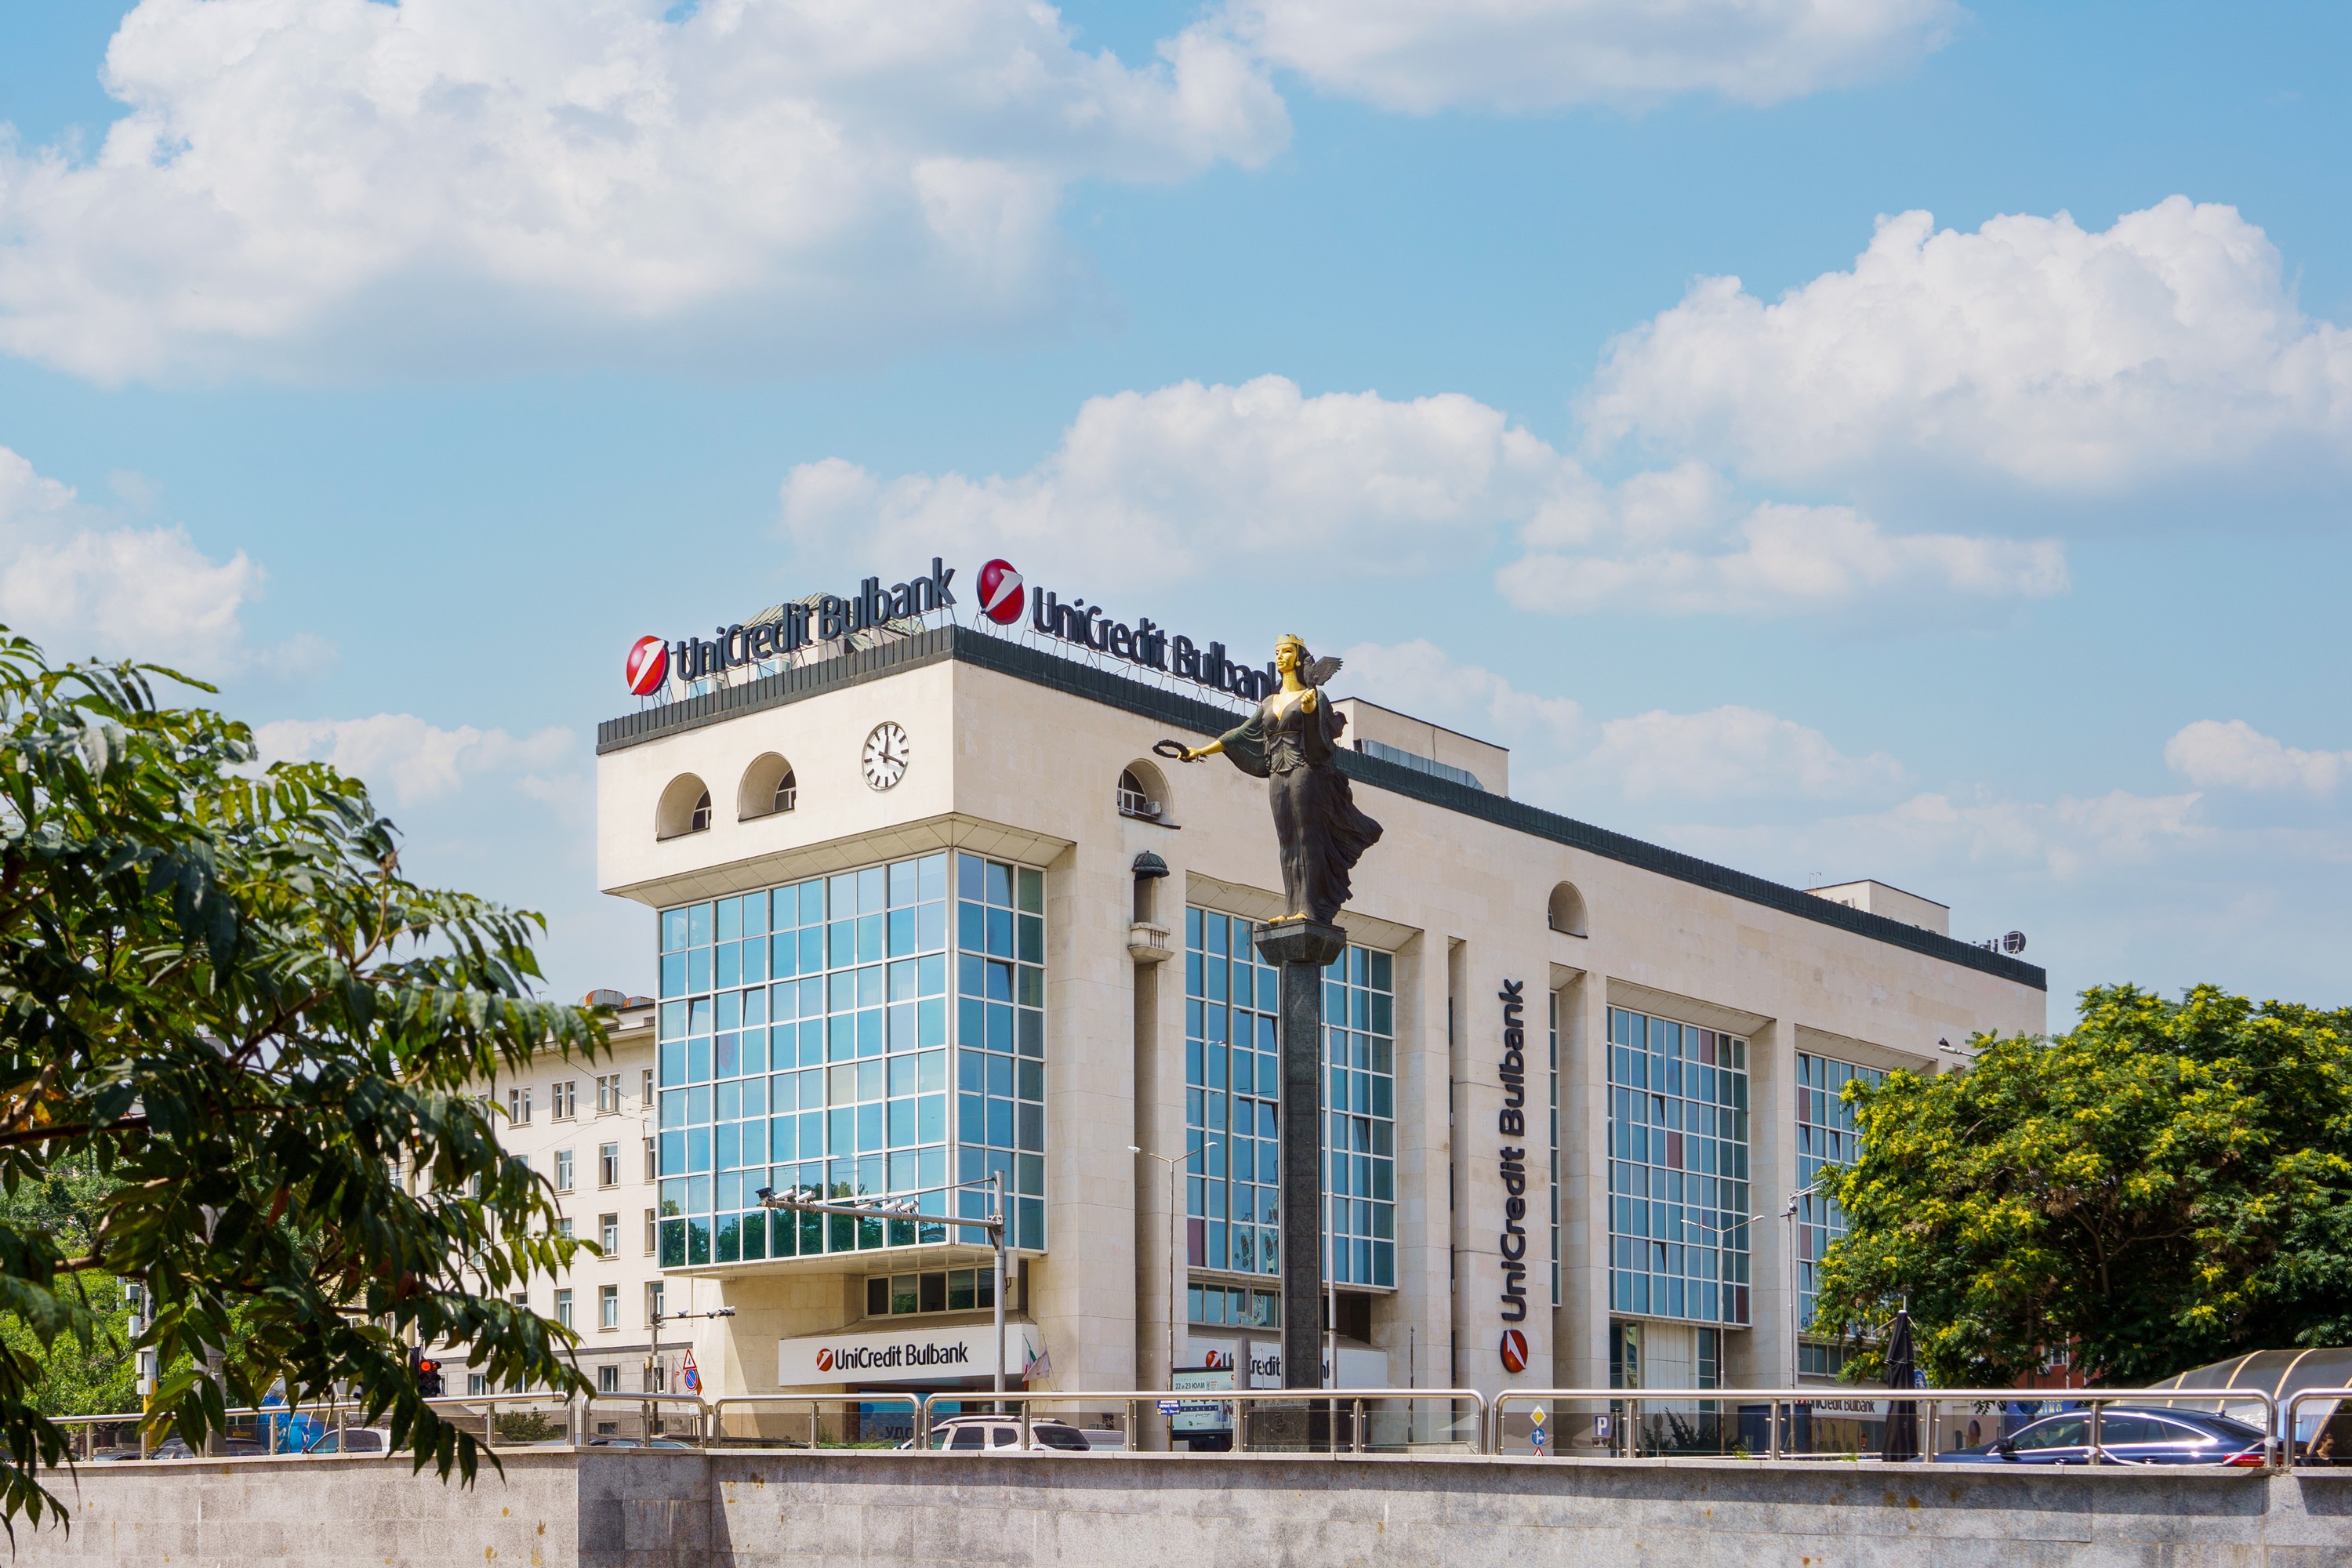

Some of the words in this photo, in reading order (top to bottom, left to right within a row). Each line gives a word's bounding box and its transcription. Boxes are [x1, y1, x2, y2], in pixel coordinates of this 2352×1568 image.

[677, 603, 813, 681] UniCredit
[818, 557, 956, 641] Bulbank
[1033, 586, 1168, 672] UniCredit
[1498, 978, 1525, 1137] Bulbank
[1500, 1146, 1526, 1322] UniCredit
[835, 1345, 902, 1370] UniCredit
[906, 1341, 969, 1366] Bulbank
[1597, 1416, 1608, 1436] P
